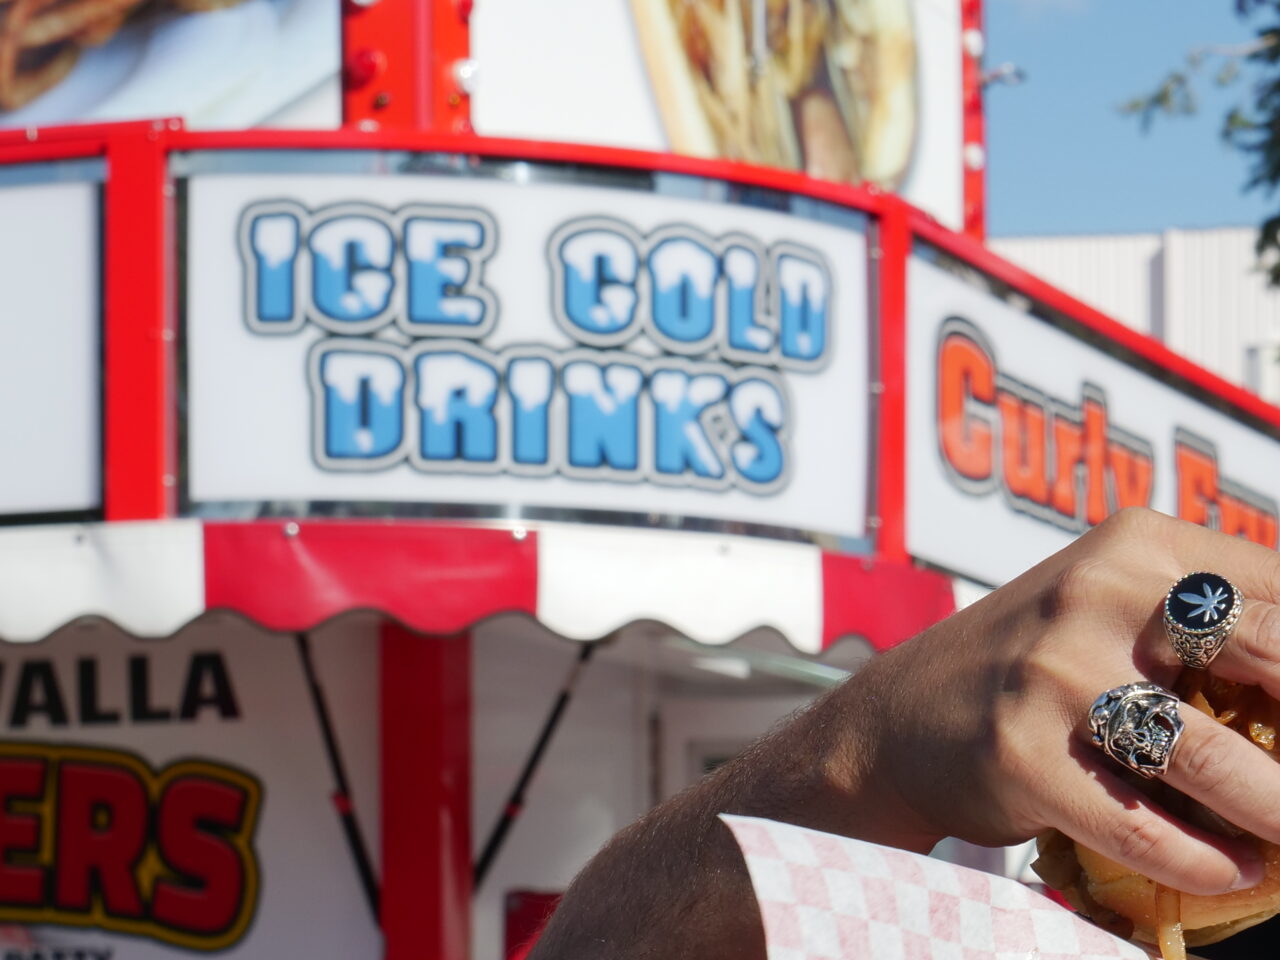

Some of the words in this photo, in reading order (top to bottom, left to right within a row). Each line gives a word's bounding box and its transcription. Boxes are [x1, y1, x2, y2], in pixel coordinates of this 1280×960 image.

[243, 205, 494, 331] ICE
[554, 222, 830, 367] COLD
[312, 345, 789, 490] DRINKS
[0, 652, 241, 729] ALLA
